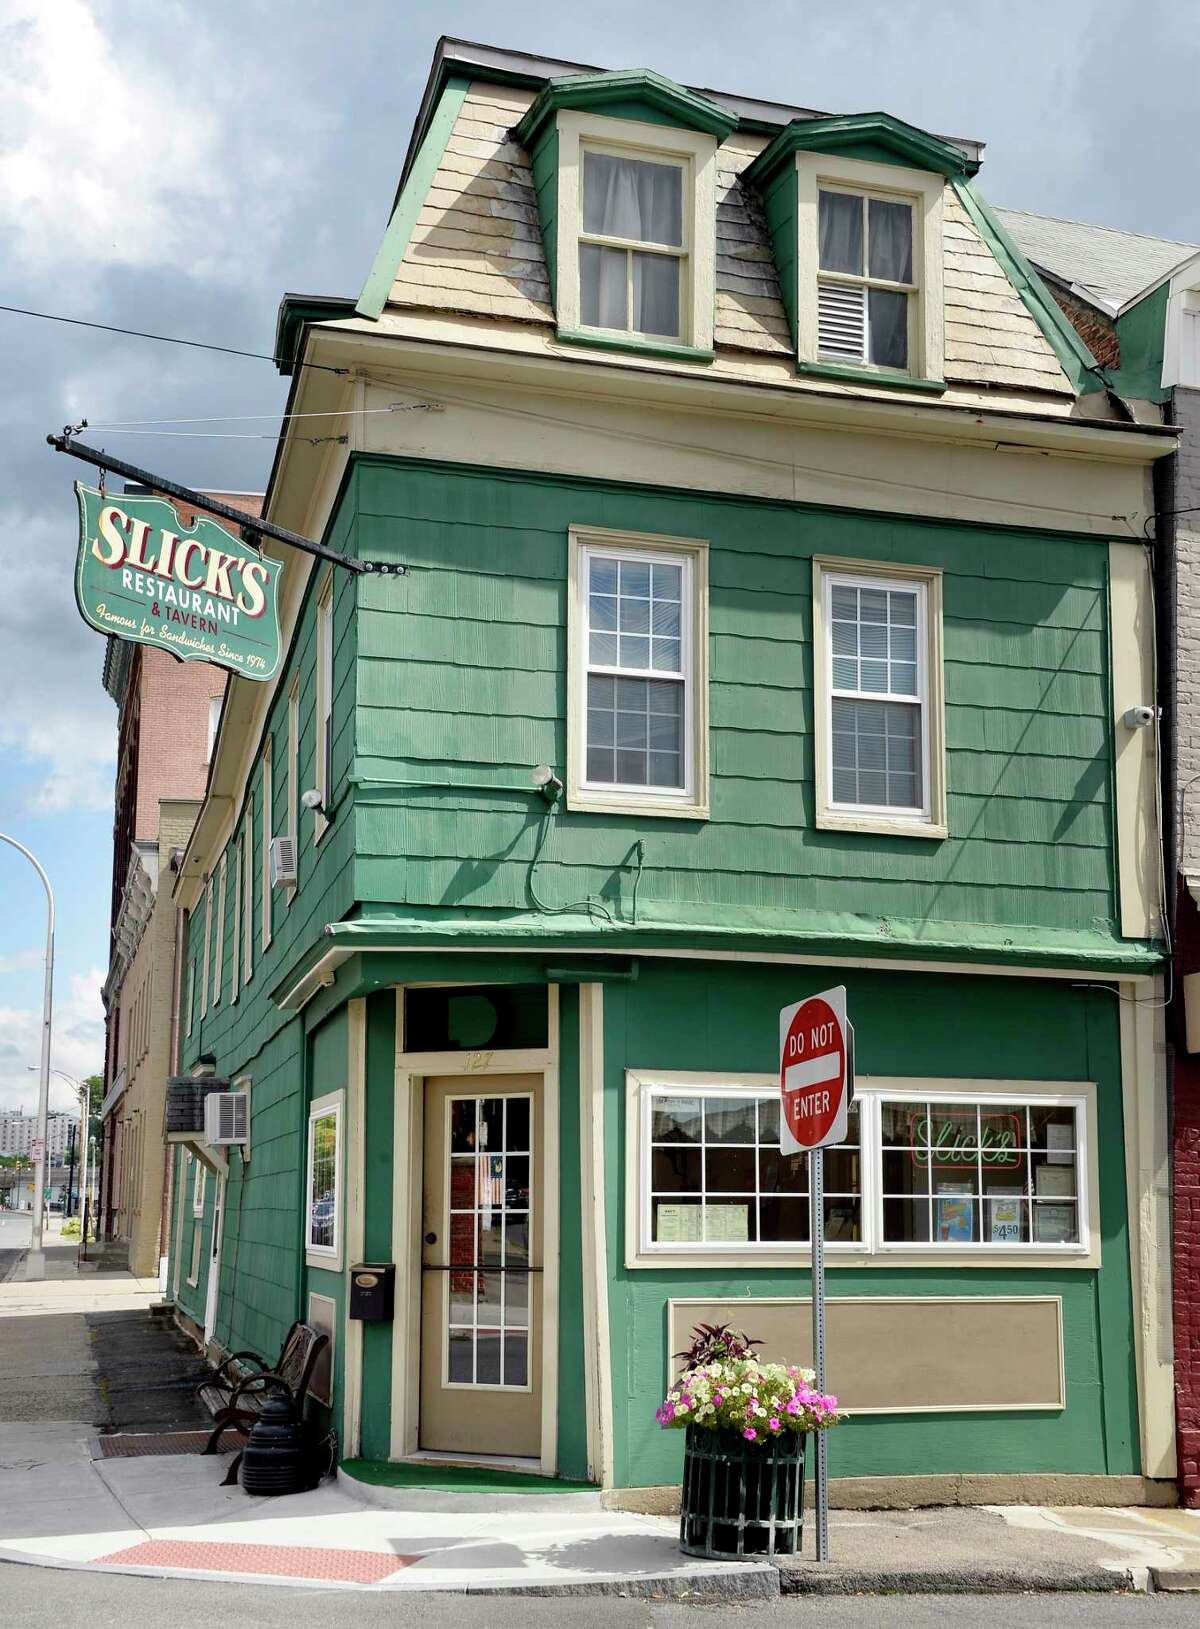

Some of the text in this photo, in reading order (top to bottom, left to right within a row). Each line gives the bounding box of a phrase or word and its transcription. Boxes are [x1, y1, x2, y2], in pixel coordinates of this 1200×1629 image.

[91, 506, 269, 619] SLICK'S
[122, 569, 240, 625] RESTAURANT
[151, 602, 218, 635] & TAVERN
[95, 603, 267, 669] Famous for Sandwiches Since 1974
[790, 1022, 835, 1057] DO NOT
[793, 1090, 830, 1121] ENTER
